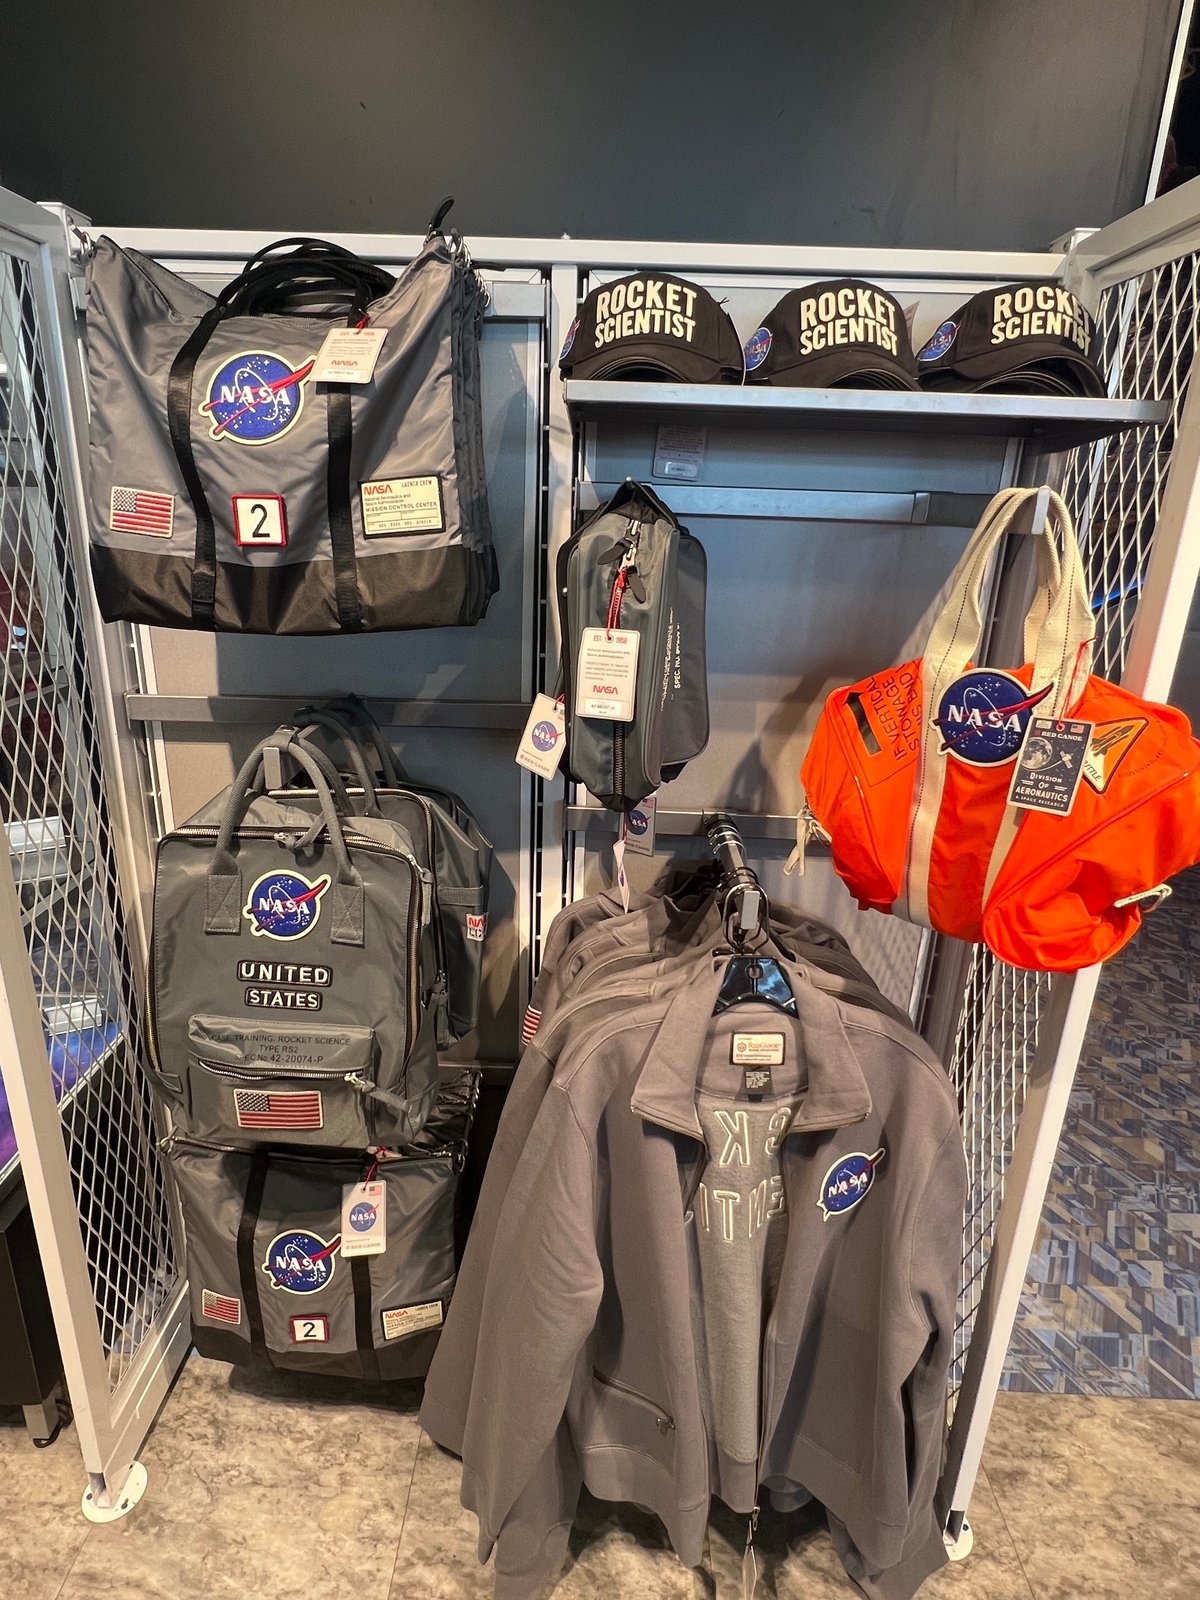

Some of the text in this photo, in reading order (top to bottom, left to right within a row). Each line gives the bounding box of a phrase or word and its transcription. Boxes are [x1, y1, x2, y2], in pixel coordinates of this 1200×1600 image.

[596, 280, 697, 323] ROCKET
[800, 288, 895, 332] ROCKET
[993, 286, 1090, 334] ROCKET
[594, 309, 696, 349] SCIENTIST
[799, 318, 897, 356] SCIENTIST
[990, 311, 1091, 357] SCIENTIST
[331, 359, 358, 367] NASA
[219, 385, 291, 406] NASA
[364, 484, 392, 495] NASA
[389, 503, 414, 511] CONTROL
[250, 503, 271, 538] 2
[593, 684, 619, 695] NASA
[899, 672, 919, 704] END
[866, 676, 908, 760] IF VERTICAL
[882, 676, 919, 751] STOWAGE
[947, 704, 1022, 732] NASA
[533, 728, 556, 745] NASA
[1057, 733, 1083, 741] CANOE
[1015, 786, 1068, 802] AERONAUTICS
[259, 897, 310, 915] NASA
[241, 962, 329, 984] UNITED
[249, 989, 318, 1008] STATES
[259, 1044, 299, 1054] TYPE RS2
[278, 1035, 313, 1044] ROCKET
[314, 1036, 351, 1046] SCIENCE
[269, 1054, 324, 1063] 42-20074-P
[828, 1171, 869, 1198] NASA
[351, 1212, 376, 1222] NASA
[275, 1255, 327, 1272] NASA
[385, 1309, 408, 1319] NASA
[302, 1322, 317, 1338] 2
